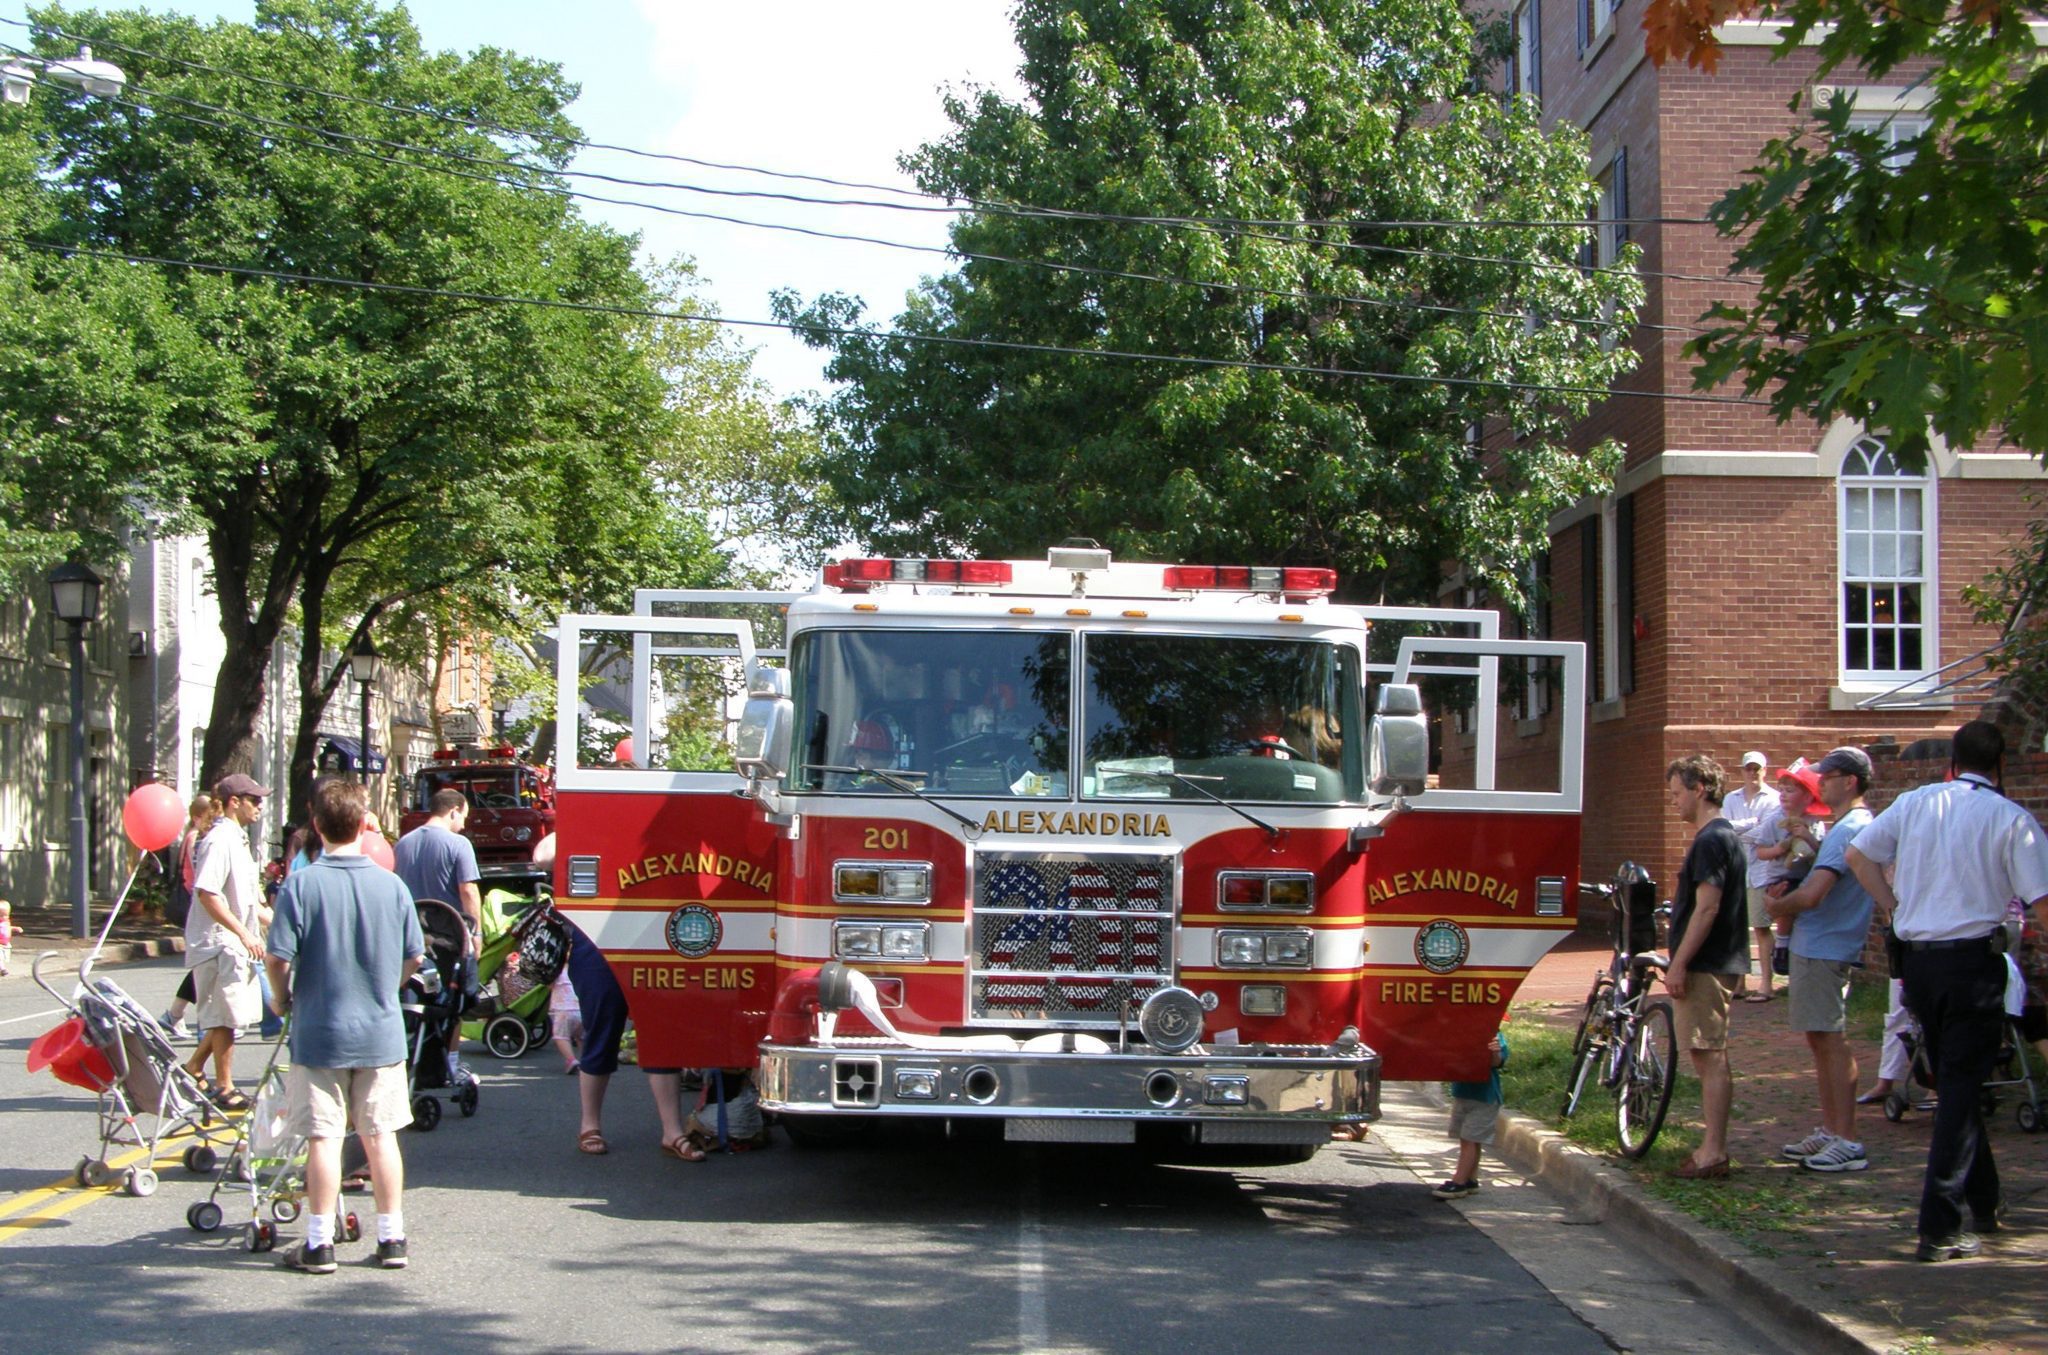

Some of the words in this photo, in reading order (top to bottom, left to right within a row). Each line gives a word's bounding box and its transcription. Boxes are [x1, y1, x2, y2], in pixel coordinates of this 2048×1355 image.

[984, 810, 1171, 836] ALEXANDRIA
[864, 828, 909, 850] 201
[617, 852, 774, 893] ALEXANDRIA
[1368, 869, 1520, 909] ALEXANDRIA
[632, 967, 755, 989] FIRE-EMS
[1381, 982, 1501, 1004] FIRE-EMS
